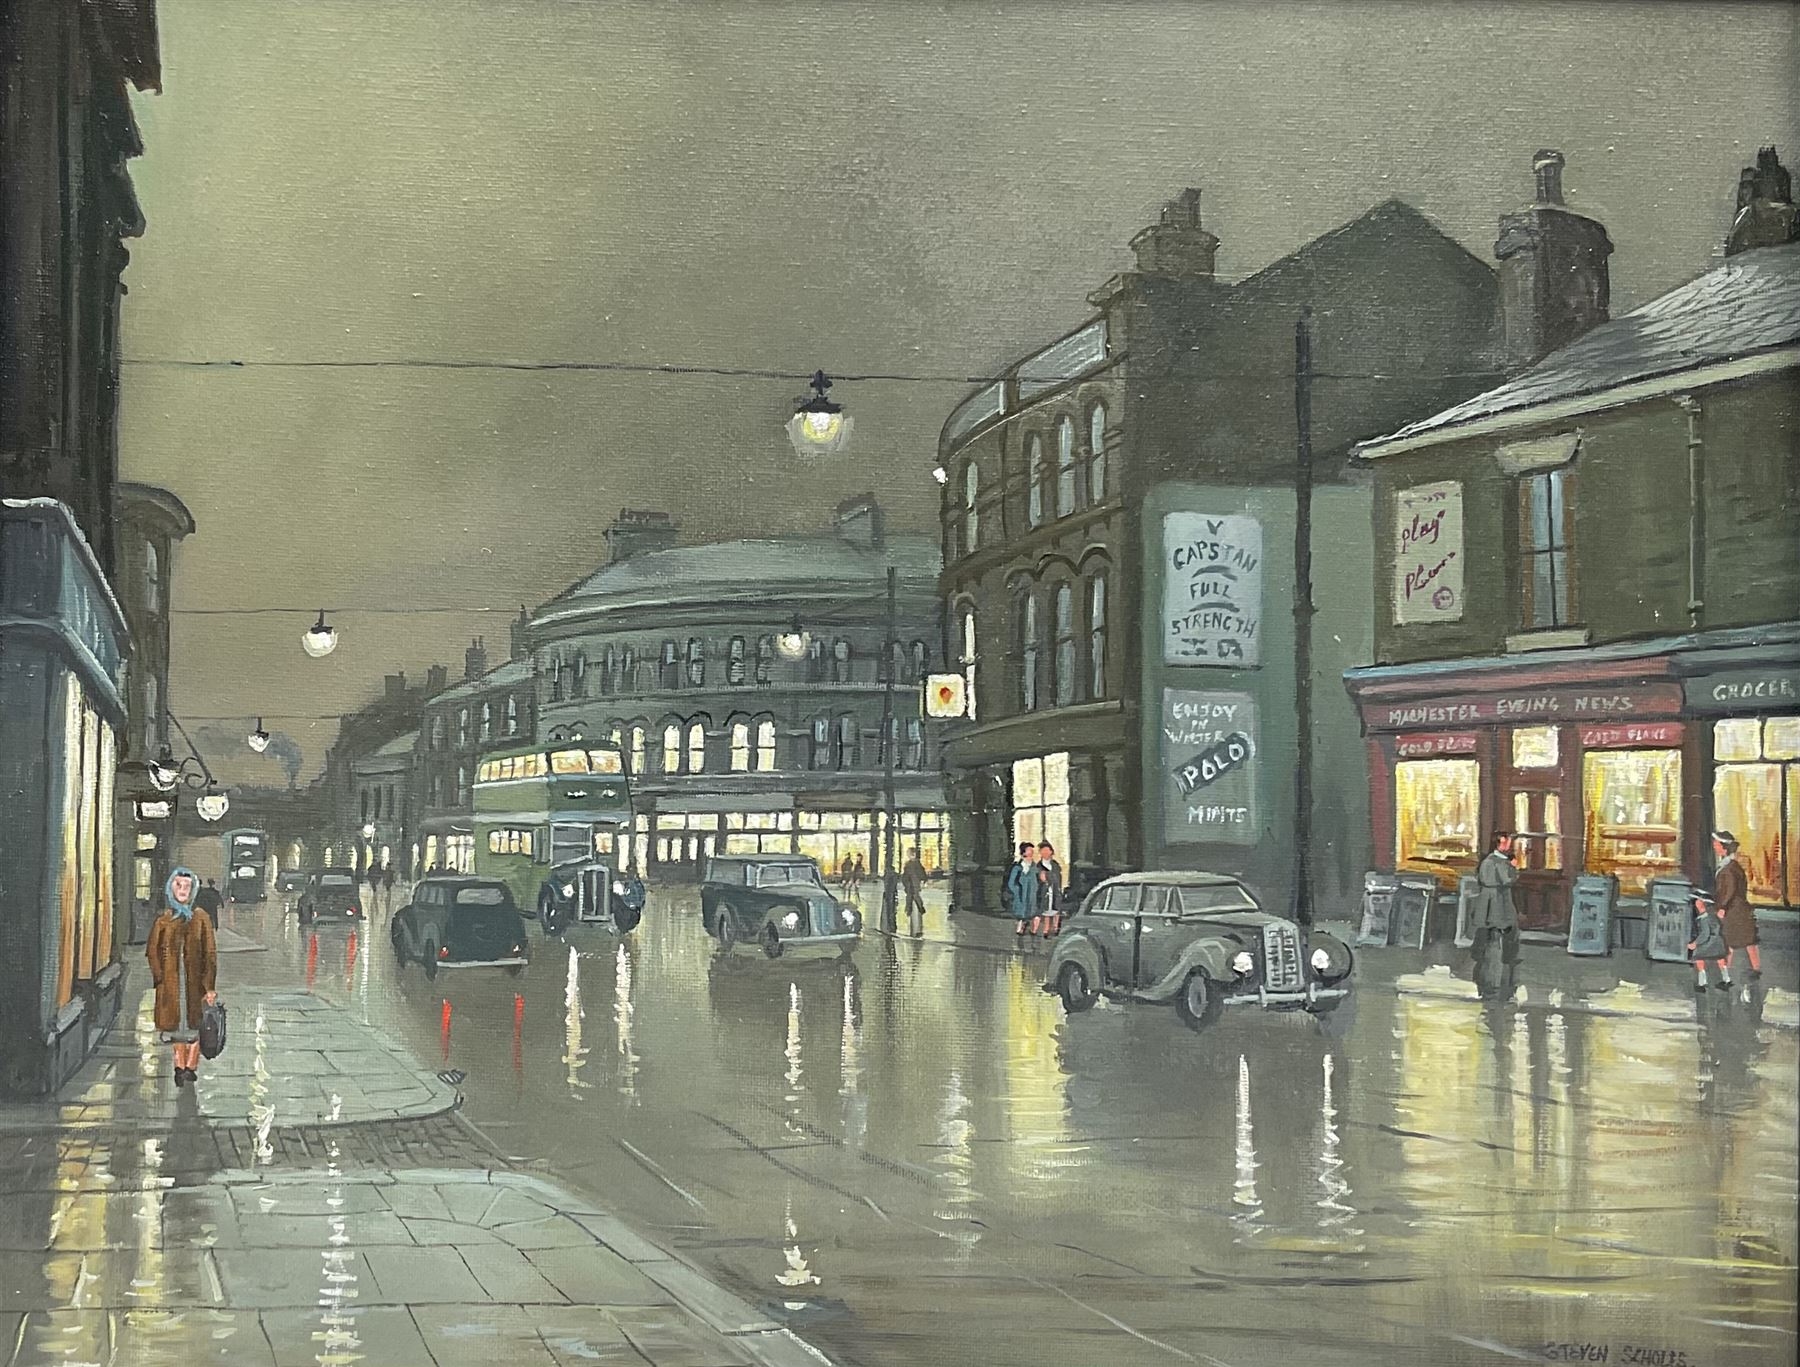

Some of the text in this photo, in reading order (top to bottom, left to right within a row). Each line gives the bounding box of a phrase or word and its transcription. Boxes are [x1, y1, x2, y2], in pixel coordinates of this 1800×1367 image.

[1173, 541, 1257, 573] CAPSTAN
[1190, 582, 1231, 600] FULL
[1171, 612, 1257, 638] STRENGTH
[1172, 702, 1238, 722] ENJOY
[1575, 695, 1633, 712] NEWS
[1183, 743, 1244, 788] POLO
